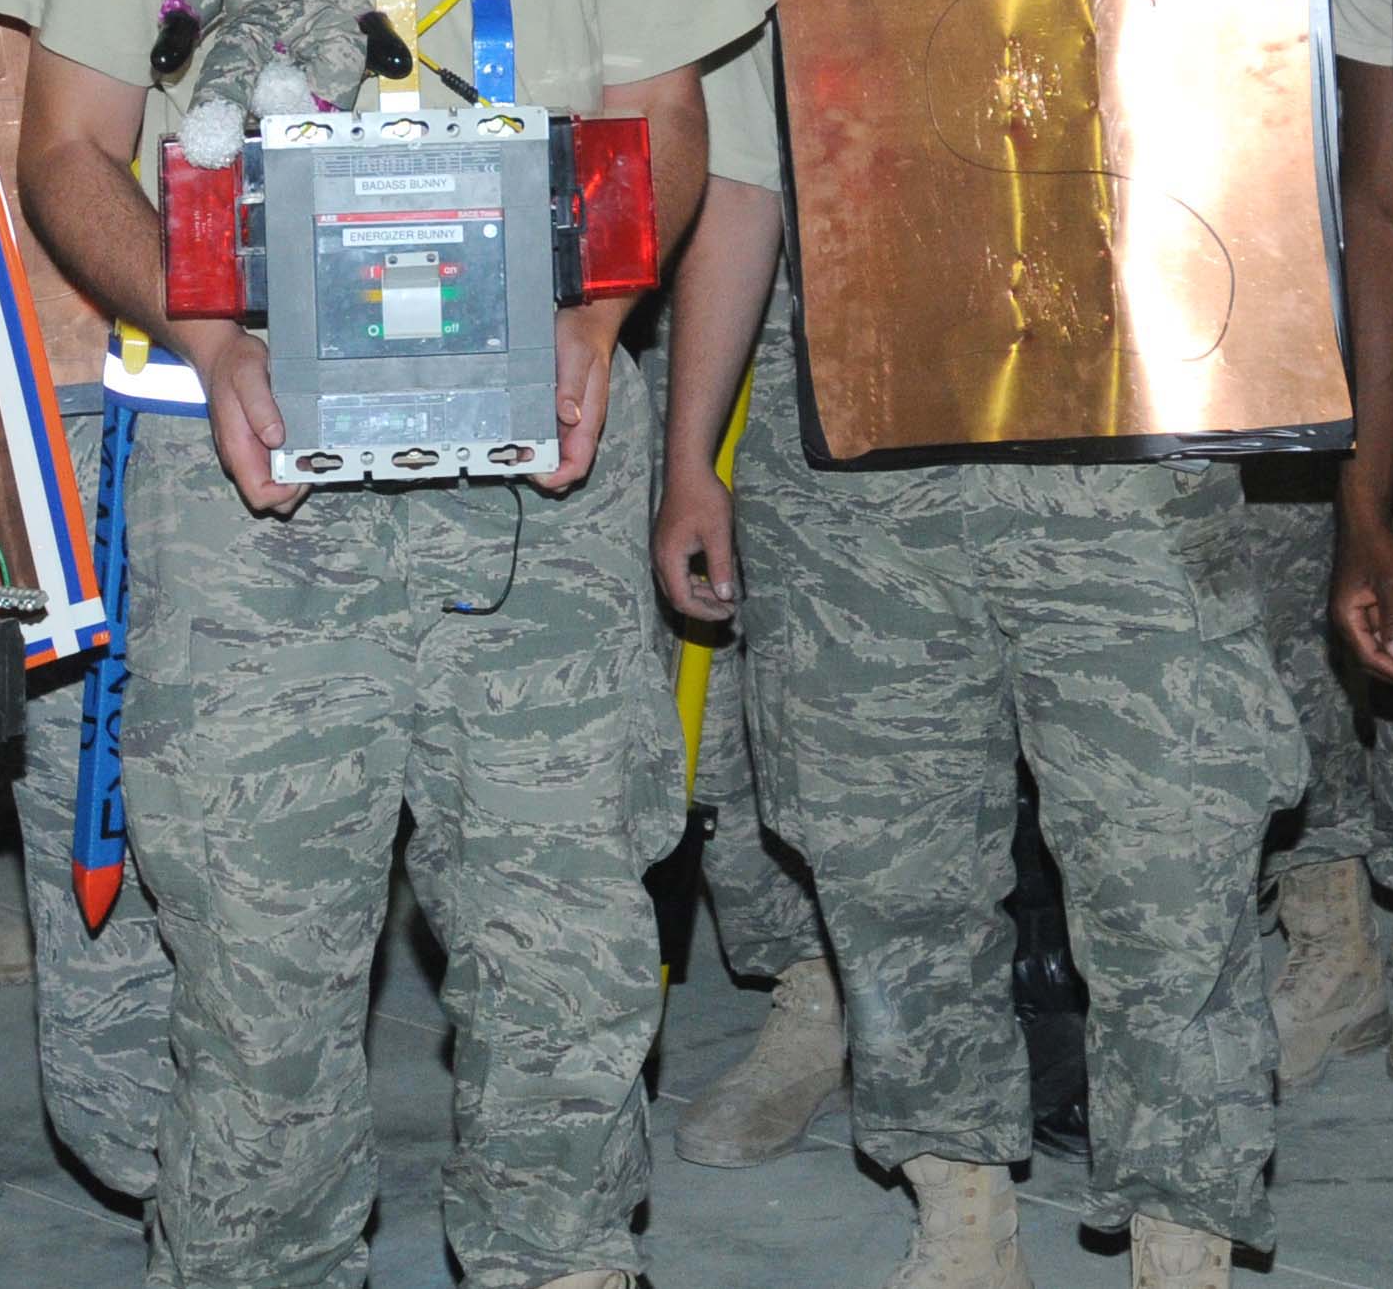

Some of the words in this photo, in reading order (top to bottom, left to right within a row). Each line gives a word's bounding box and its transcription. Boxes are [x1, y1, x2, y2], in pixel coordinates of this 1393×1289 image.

[361, 179, 407, 191] BADASS
[409, 178, 448, 189] BUNNY
[349, 230, 416, 243] ENERGIZER
[417, 229, 456, 241] BUNNY
[443, 266, 458, 275] on
[443, 322, 460, 334] off
